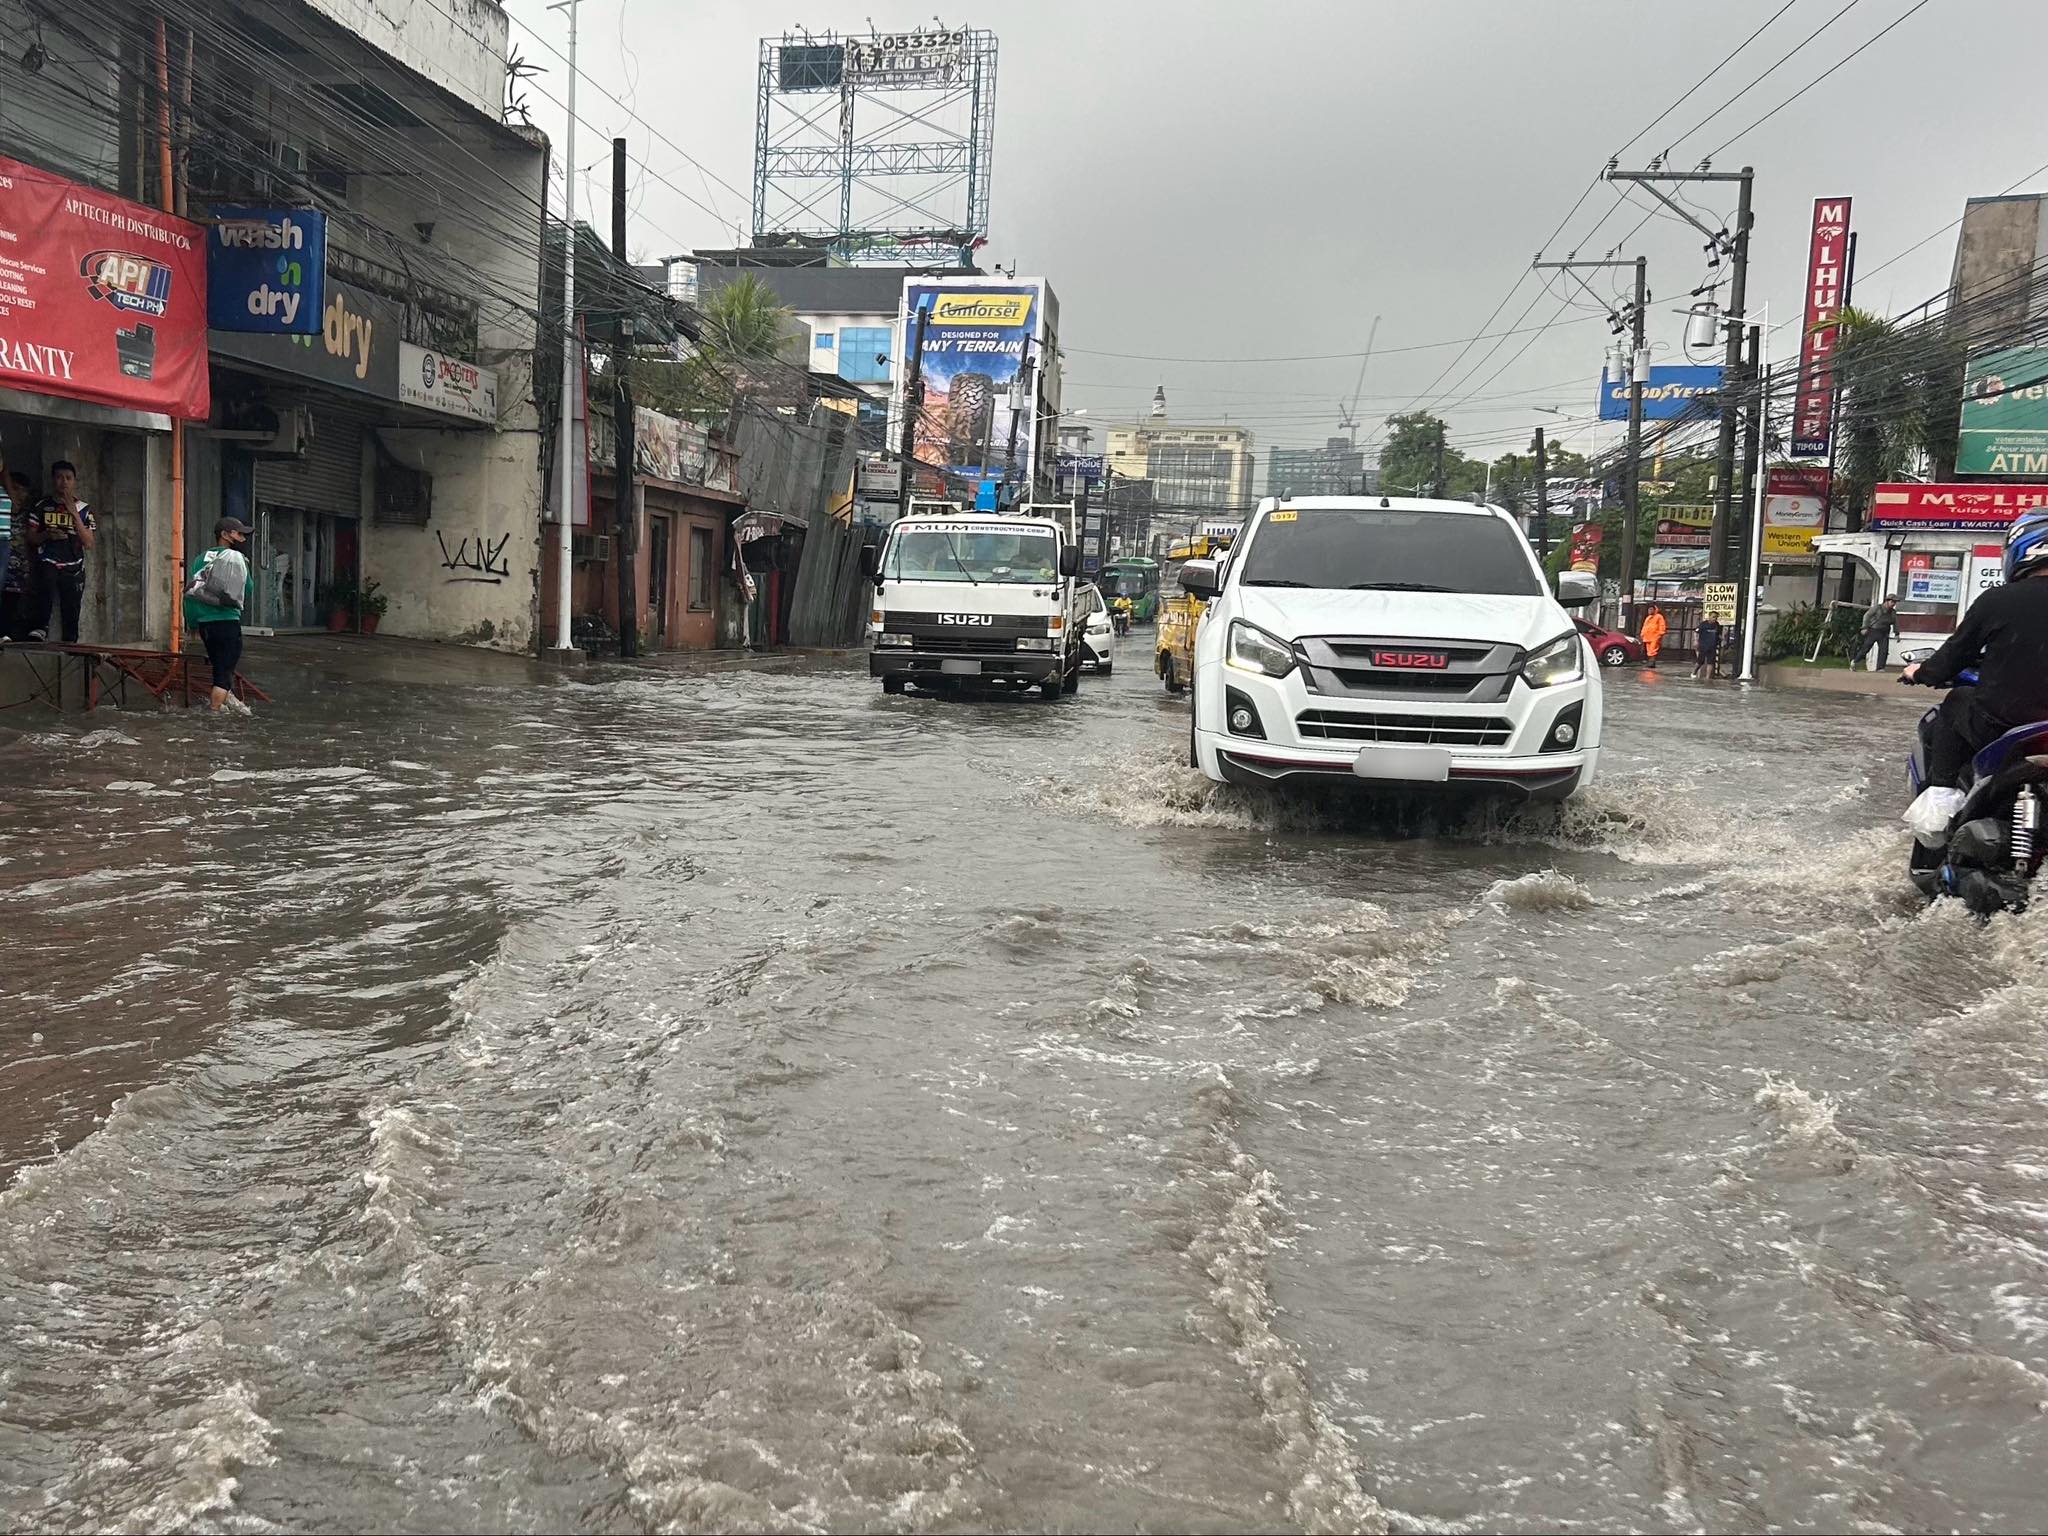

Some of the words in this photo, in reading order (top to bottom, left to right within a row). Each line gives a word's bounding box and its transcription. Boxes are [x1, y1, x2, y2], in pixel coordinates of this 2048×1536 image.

[920, 53, 957, 69] SPAC
[64, 198, 109, 225] APITECH
[111, 213, 125, 230] PH
[127, 218, 191, 251] DISTRIBUTOR
[218, 218, 303, 250] wash
[20, 261, 47, 276] Services
[100, 254, 149, 291] API
[17, 298, 36, 311] RESET
[115, 291, 146, 310] TECH
[146, 302, 160, 313] PH
[248, 284, 300, 325] dry
[940, 300, 1020, 318] Comforser
[324, 293, 372, 379] dry
[941, 331, 981, 339] DESIGNED
[983, 331, 999, 339] FOR
[922, 341, 953, 352] ANY
[956, 341, 1023, 353] TERRAIN
[0, 336, 74, 381] RANTY
[1611, 383, 1718, 400] GOODYEAR
[1796, 442, 1824, 451] TIPOLO
[1989, 453, 2048, 472] ATM
[1929, 520, 1950, 528] Loan
[1960, 521, 2000, 529] KWARTA
[1768, 532, 1800, 540] Western
[1907, 557, 1925, 567] ria
[1980, 568, 2001, 577] GET
[1707, 585, 1734, 593] SLOW
[1706, 594, 1734, 602] DOWN
[937, 614, 993, 626] ISUZU
[1375, 653, 1445, 667] ISUZU
